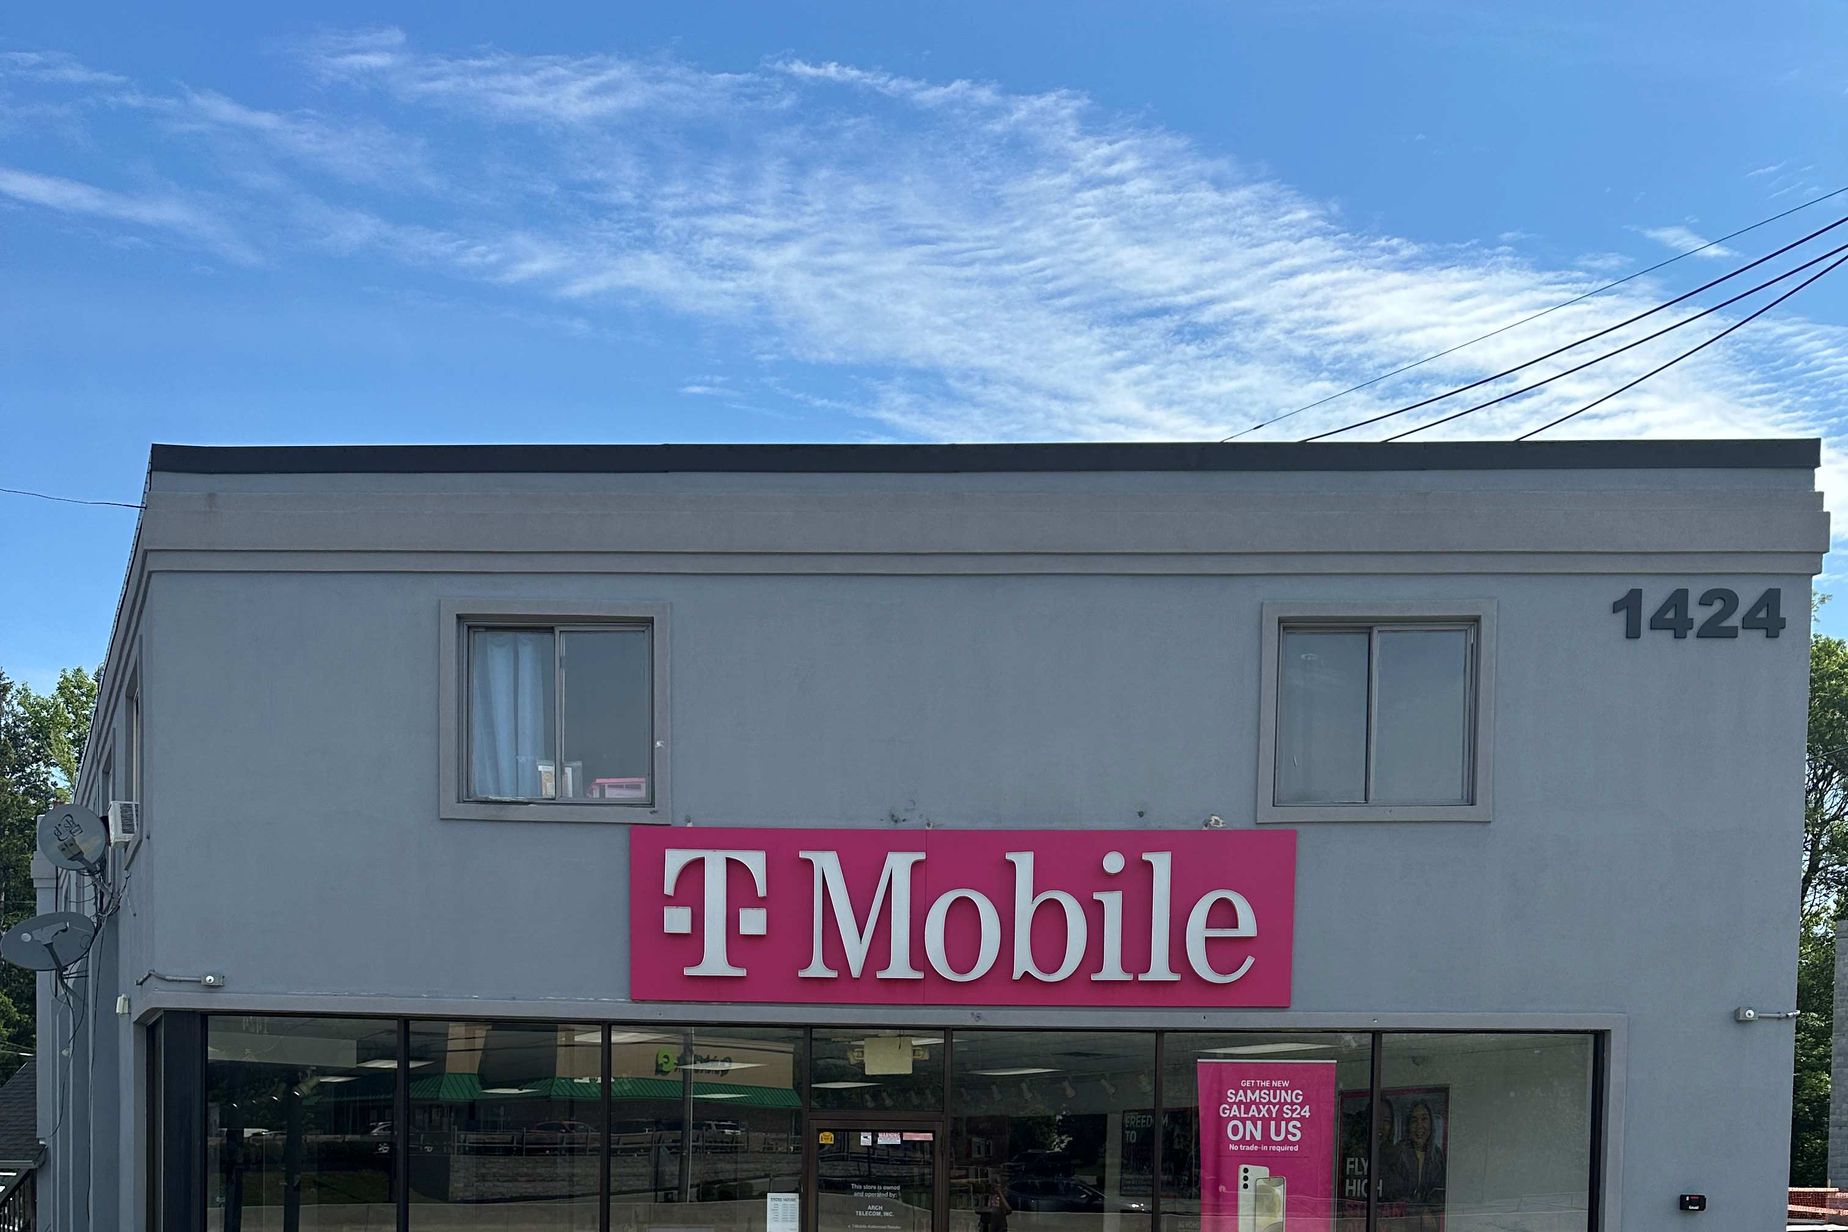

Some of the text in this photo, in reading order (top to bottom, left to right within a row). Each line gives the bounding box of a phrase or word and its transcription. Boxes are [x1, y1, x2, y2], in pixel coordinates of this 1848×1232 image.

[1612, 588, 1786, 639] 1424
[663, 848, 1258, 984] T Mobile
[1227, 1089, 1303, 1103] SAMSUNG
[1219, 1104, 1310, 1118] GALAXY S24
[1125, 1114, 1168, 1128] FREEDM
[1125, 1130, 1137, 1143] TO
[1227, 1120, 1302, 1142] ON US
[1269, 1144, 1299, 1153] required
[1346, 1157, 1369, 1176] FLY
